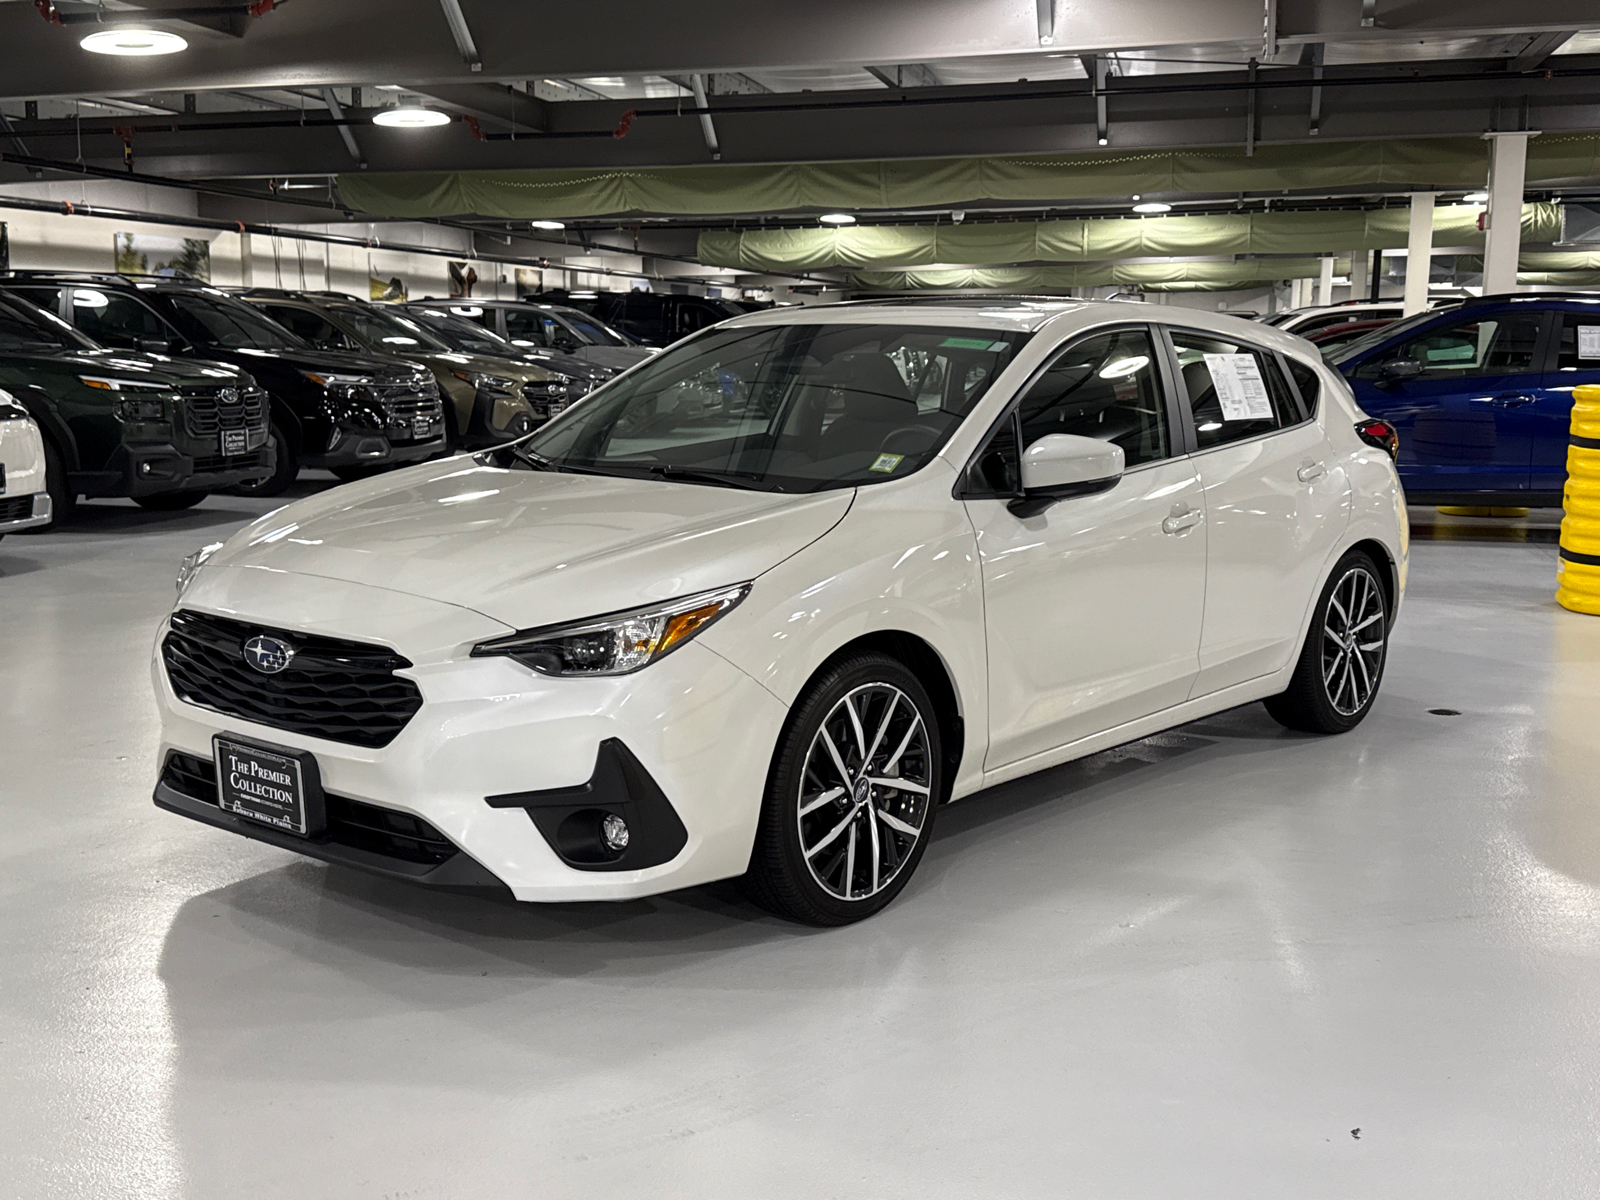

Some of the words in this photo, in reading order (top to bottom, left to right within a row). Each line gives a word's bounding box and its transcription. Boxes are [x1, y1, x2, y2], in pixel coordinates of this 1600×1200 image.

[229, 755, 250, 775] THE
[250, 761, 292, 786] PREMIER
[230, 772, 293, 804] COLLECTION
